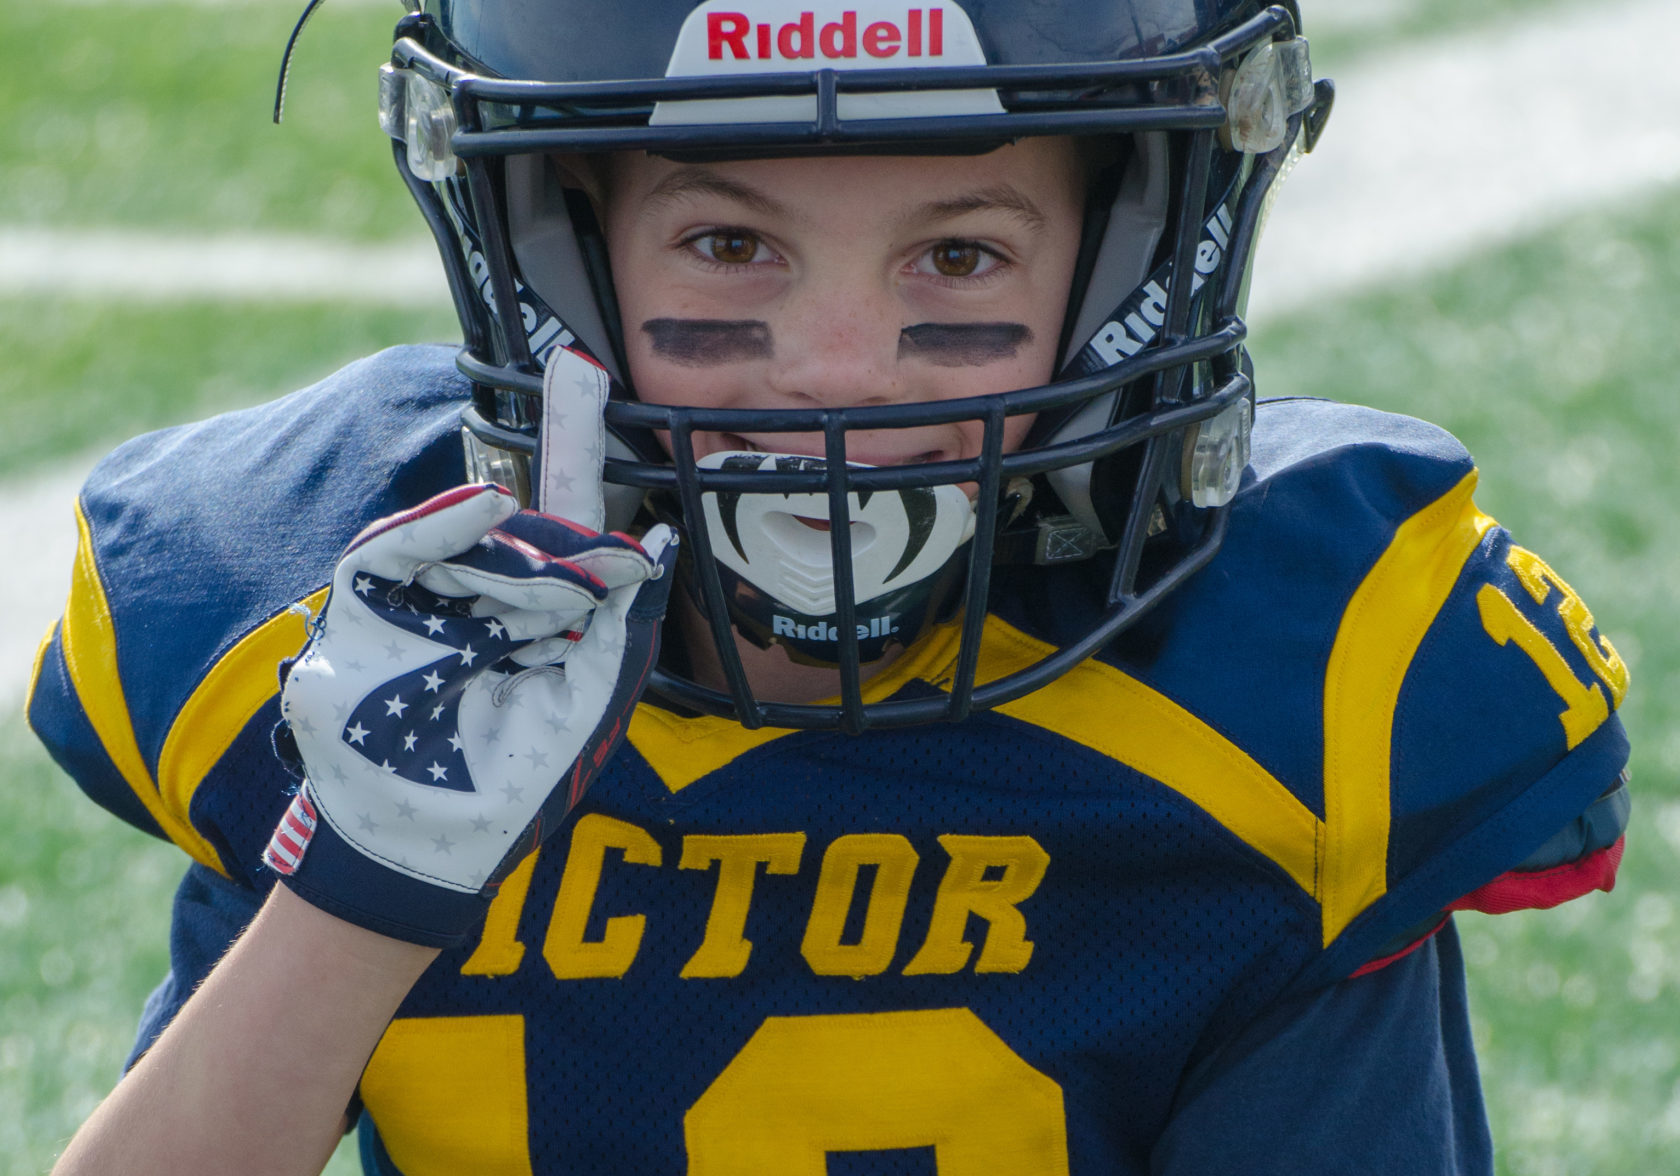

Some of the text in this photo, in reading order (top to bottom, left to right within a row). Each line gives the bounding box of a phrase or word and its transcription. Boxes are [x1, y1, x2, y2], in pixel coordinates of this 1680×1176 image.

[707, 8, 943, 60] Riddell
[448, 200, 576, 368] dell
[1090, 203, 1232, 366] Ridell
[1476, 545, 1630, 751] 12
[460, 813, 1051, 981] ICTOR
